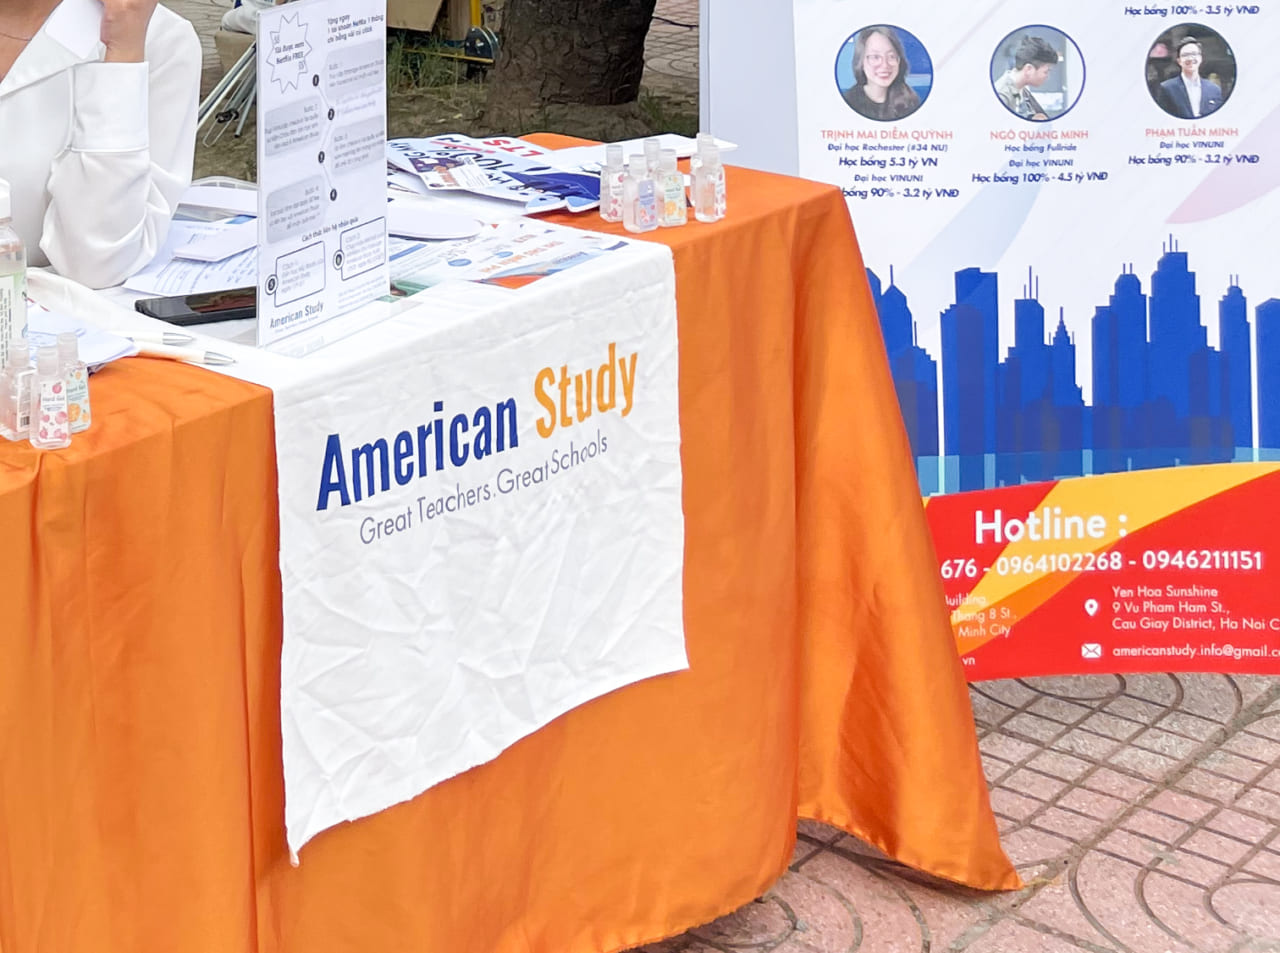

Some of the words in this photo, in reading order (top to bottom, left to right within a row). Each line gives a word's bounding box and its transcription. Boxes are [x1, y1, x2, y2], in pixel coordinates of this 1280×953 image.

[1209, 128, 1239, 137] MINH
[316, 397, 519, 511] American
[534, 342, 638, 439] Study
[359, 507, 413, 545] Great
[551, 429, 608, 478] Schools
[975, 506, 1106, 544] Hotline
[997, 551, 1122, 575] 0964102268
[1143, 549, 1264, 571] 0946211151
[1112, 586, 1133, 598] Yen
[1137, 586, 1163, 598] Hoa
[1166, 586, 1218, 598] Sunshine
[1112, 602, 1120, 614] 9
[1124, 602, 1139, 613] Vu
[1143, 602, 1174, 613] Pham
[1178, 602, 1207, 613] Ham
[958, 625, 986, 637] Minh
[990, 624, 1011, 638] City
[1112, 618, 1136, 630] Cau
[1139, 617, 1169, 632] Giay
[1173, 617, 1215, 631] District,
[1220, 618, 1238, 630] Ha
[1243, 619, 1265, 630] Noi
